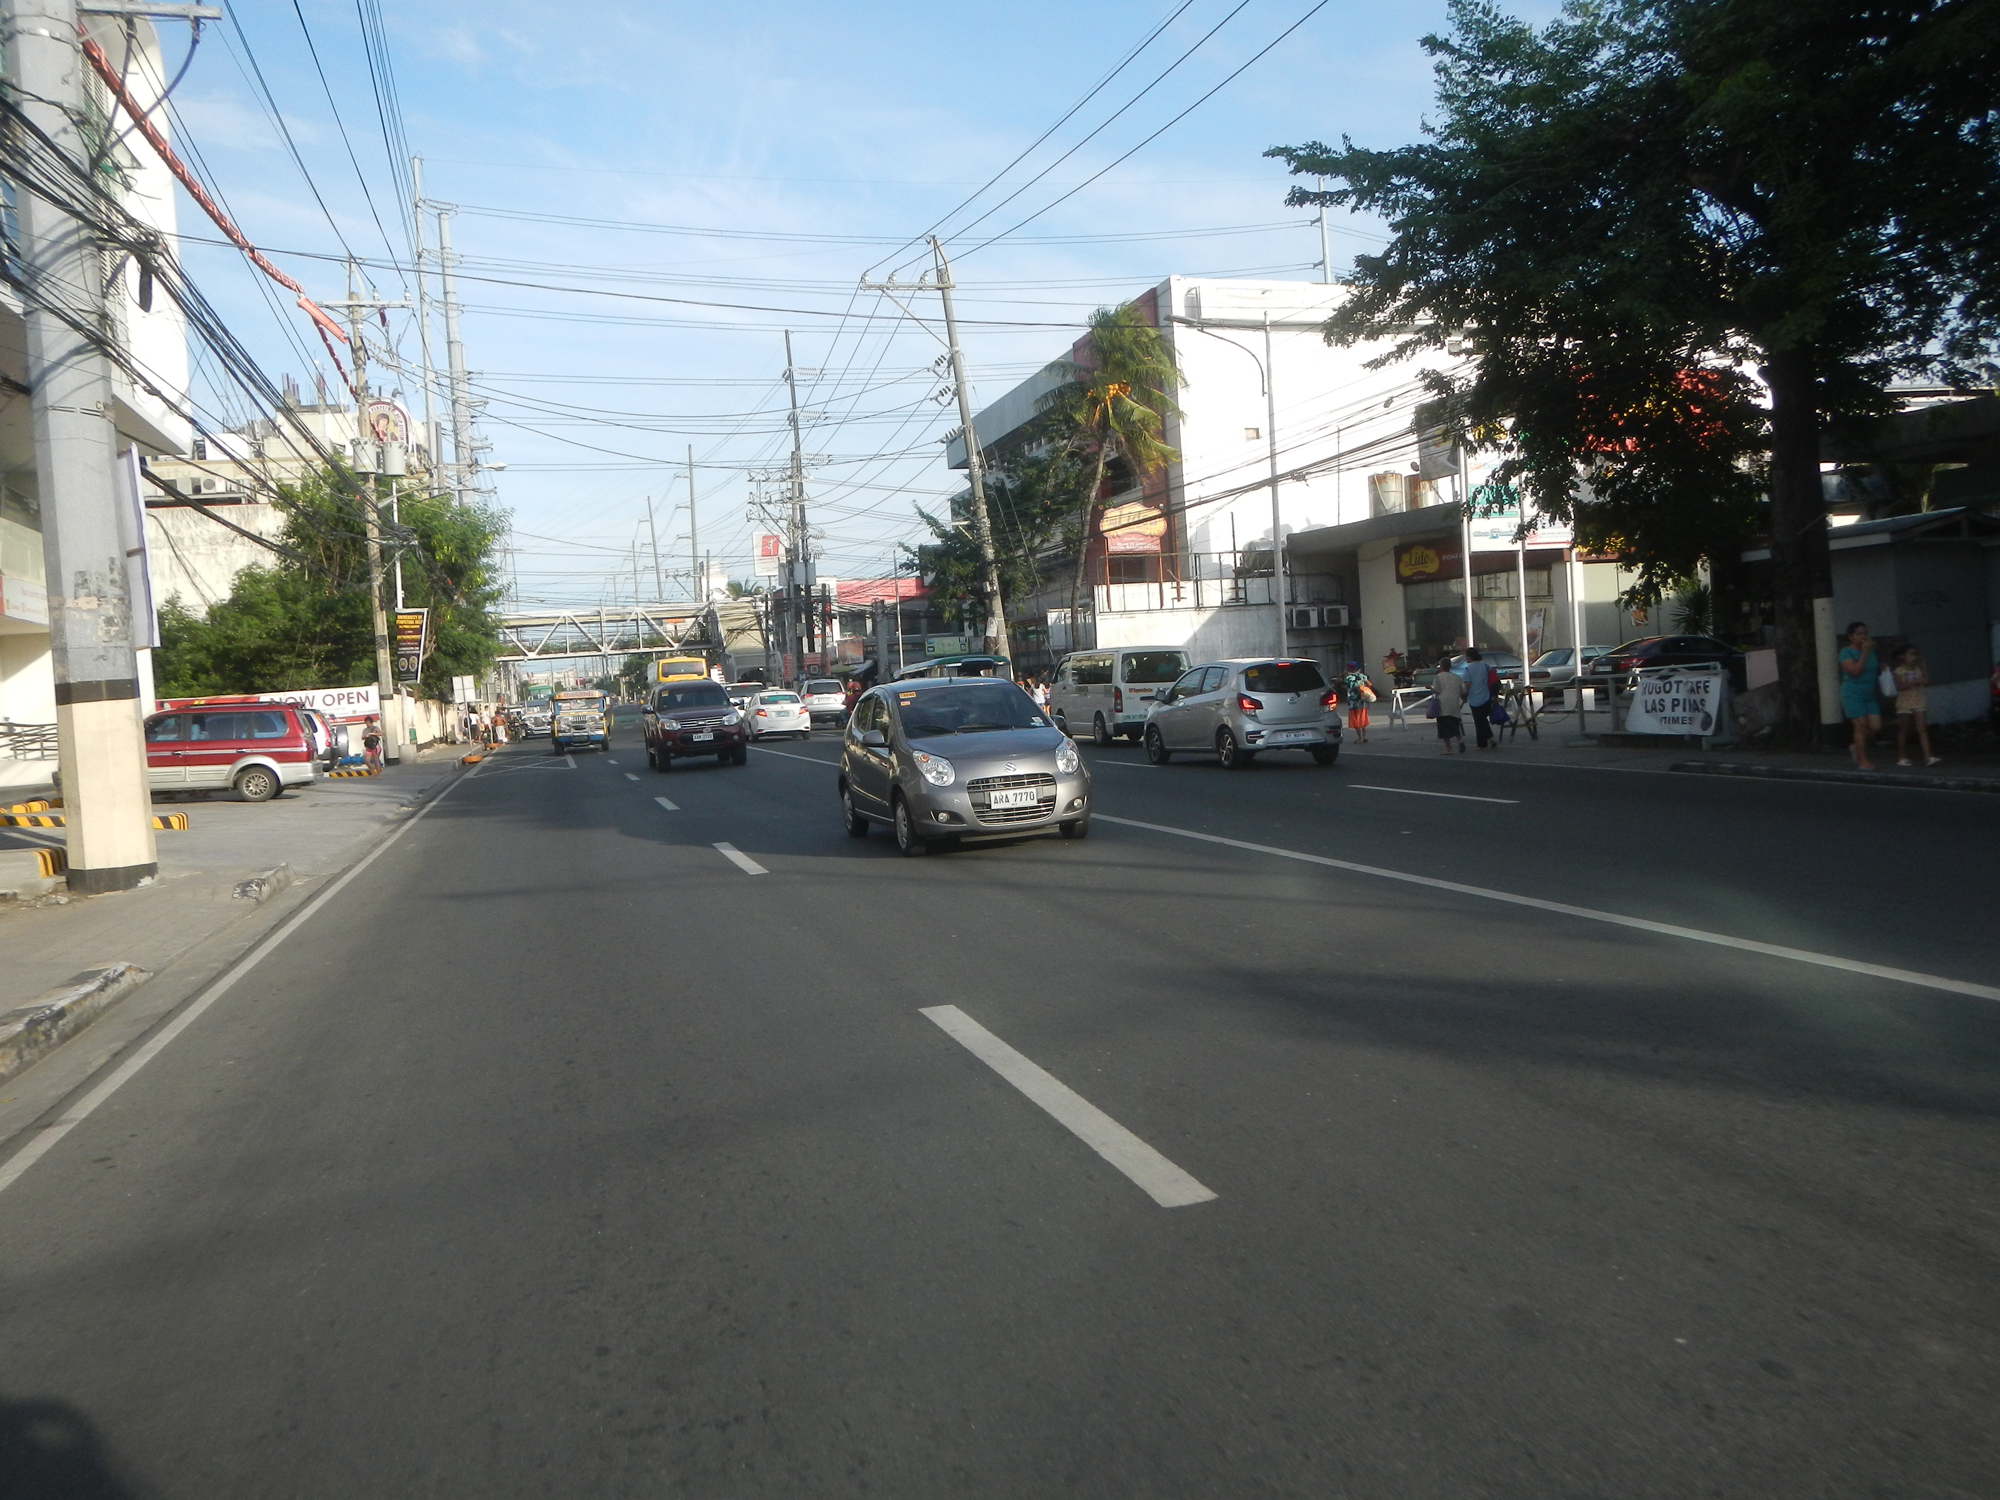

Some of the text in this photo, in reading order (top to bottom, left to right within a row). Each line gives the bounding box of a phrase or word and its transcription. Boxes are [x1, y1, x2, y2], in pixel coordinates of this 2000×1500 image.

[1409, 551, 1429, 566] Lido
[322, 690, 369, 706] OPEN
[1644, 698, 1666, 713] LAS
[994, 791, 1034, 804] ARA 7770
